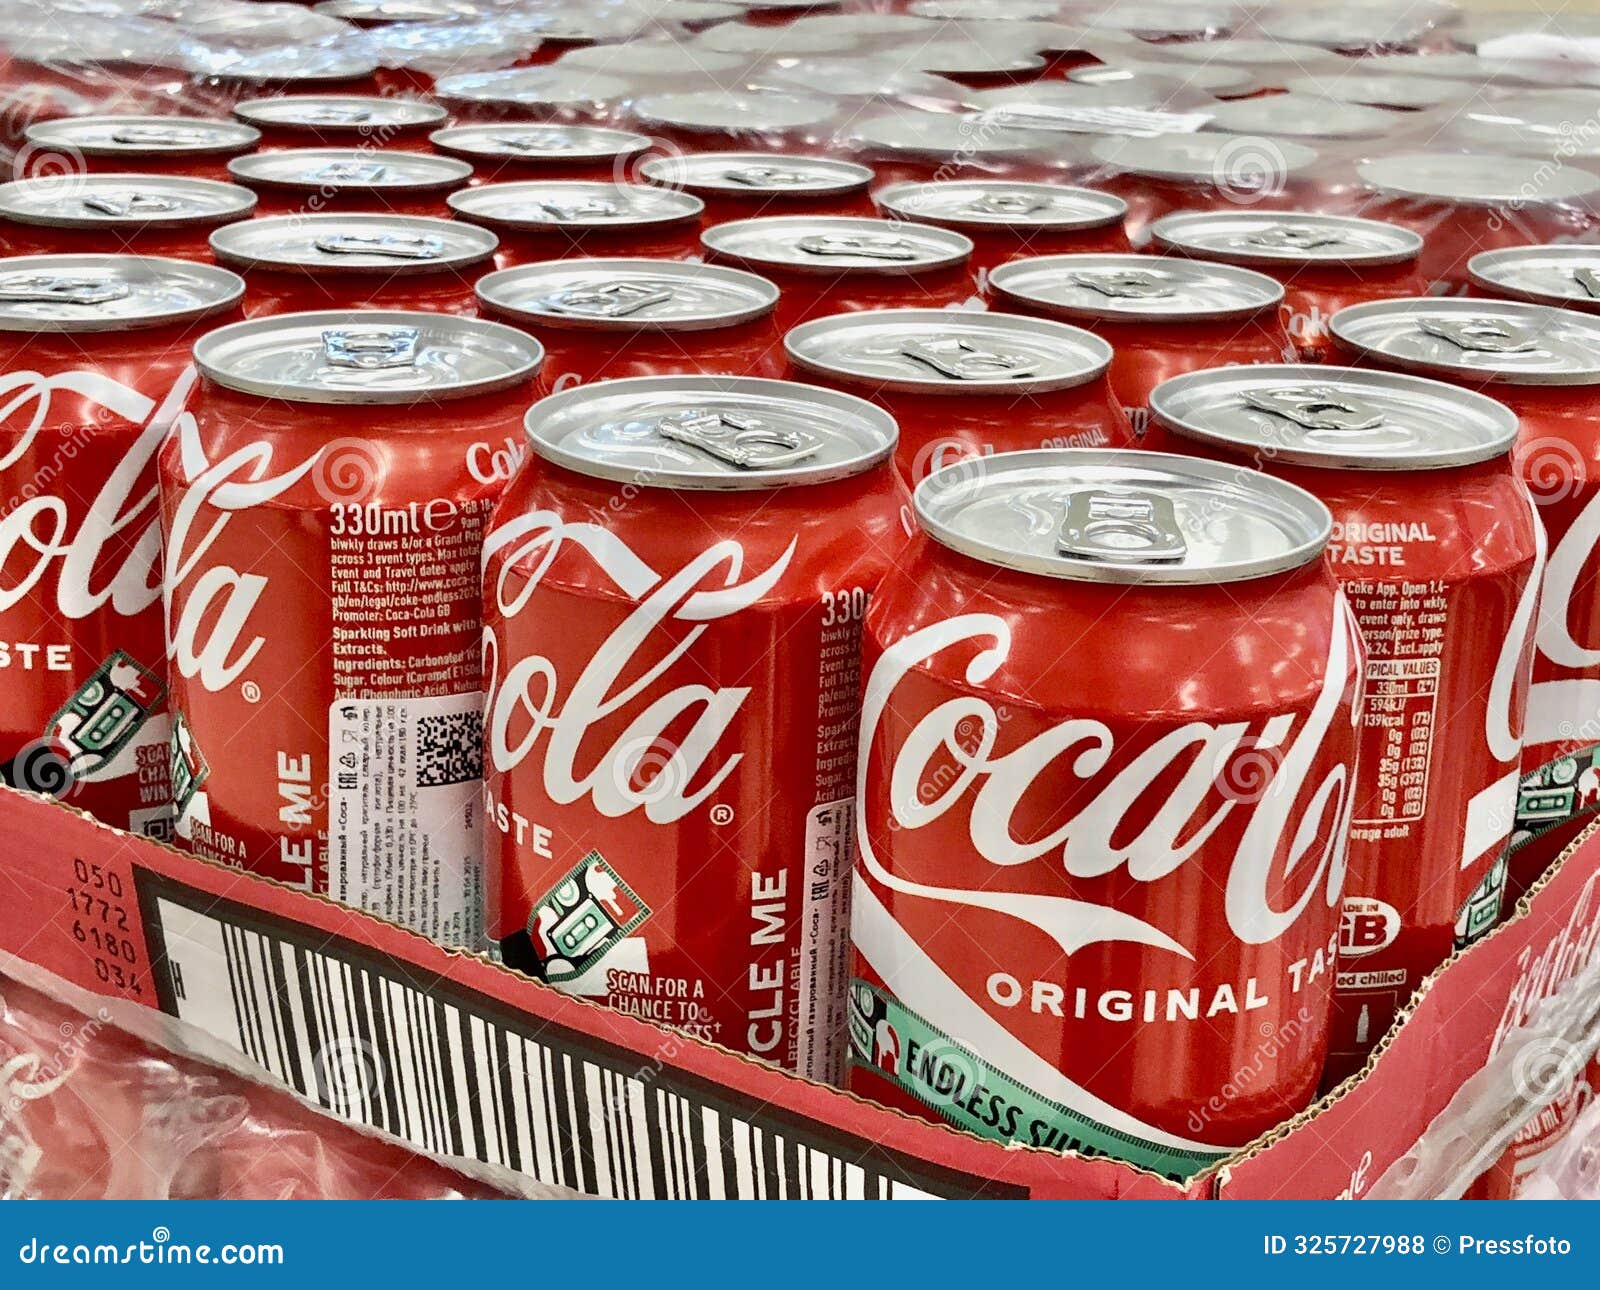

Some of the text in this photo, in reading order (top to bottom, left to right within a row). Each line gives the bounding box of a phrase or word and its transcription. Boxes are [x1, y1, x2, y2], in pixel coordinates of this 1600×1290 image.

[329, 502, 420, 535] 330ml
[1329, 521, 1436, 543] ORIGINAL
[367, 538, 398, 550] draws
[434, 532, 462, 548] Grand
[331, 554, 364, 565] across
[367, 553, 373, 564] 3
[375, 552, 403, 566] event
[1327, 544, 1405, 566] TASTE
[331, 567, 359, 579] Event
[363, 566, 381, 579] and
[385, 564, 416, 578] Travel
[420, 562, 446, 576] dates
[331, 580, 351, 593] Full
[353, 579, 384, 593] T&Cs:
[1347, 581, 1373, 594] Coke
[1376, 581, 1399, 597] App.
[1402, 581, 1427, 597] Open
[1356, 598, 1366, 609] to
[1370, 599, 1396, 610] enter
[1400, 597, 1419, 610] into
[332, 605, 450, 622] Promoter: Coca-Cola GB
[1359, 613, 1388, 625] event
[1418, 611, 1446, 623] draws
[332, 620, 476, 642] Sparkling Soft Drink with
[333, 641, 387, 655] Extracts.
[820, 643, 850, 658] across
[333, 652, 464, 673] Ingredients: Carbonated
[820, 660, 845, 674] Event
[1402, 661, 1437, 675] VALUES
[370, 673, 403, 685] Colour
[819, 675, 836, 688] Full
[334, 688, 356, 700] Acid
[1377, 682, 1408, 694] 330ml
[1363, 713, 1404, 727] 139kcal
[1379, 759, 1399, 773] 35g
[277, 751, 312, 825] ME
[1378, 774, 1397, 788] 35g
[1384, 825, 1409, 839] adult
[214, 831, 235, 854] FOR
[239, 841, 247, 858] A
[73, 858, 122, 898] 050
[66, 886, 129, 932] 1772
[751, 868, 788, 946] ME
[73, 920, 136, 964] 6180
[94, 957, 142, 995] 034
[607, 969, 705, 998] SCAN FOR A
[1360, 971, 1404, 985] chilled
[985, 971, 1269, 1023] ORIGINAL
[608, 993, 699, 1021] CHANCE TO
[905, 1038, 1024, 1137] ENDLESS
